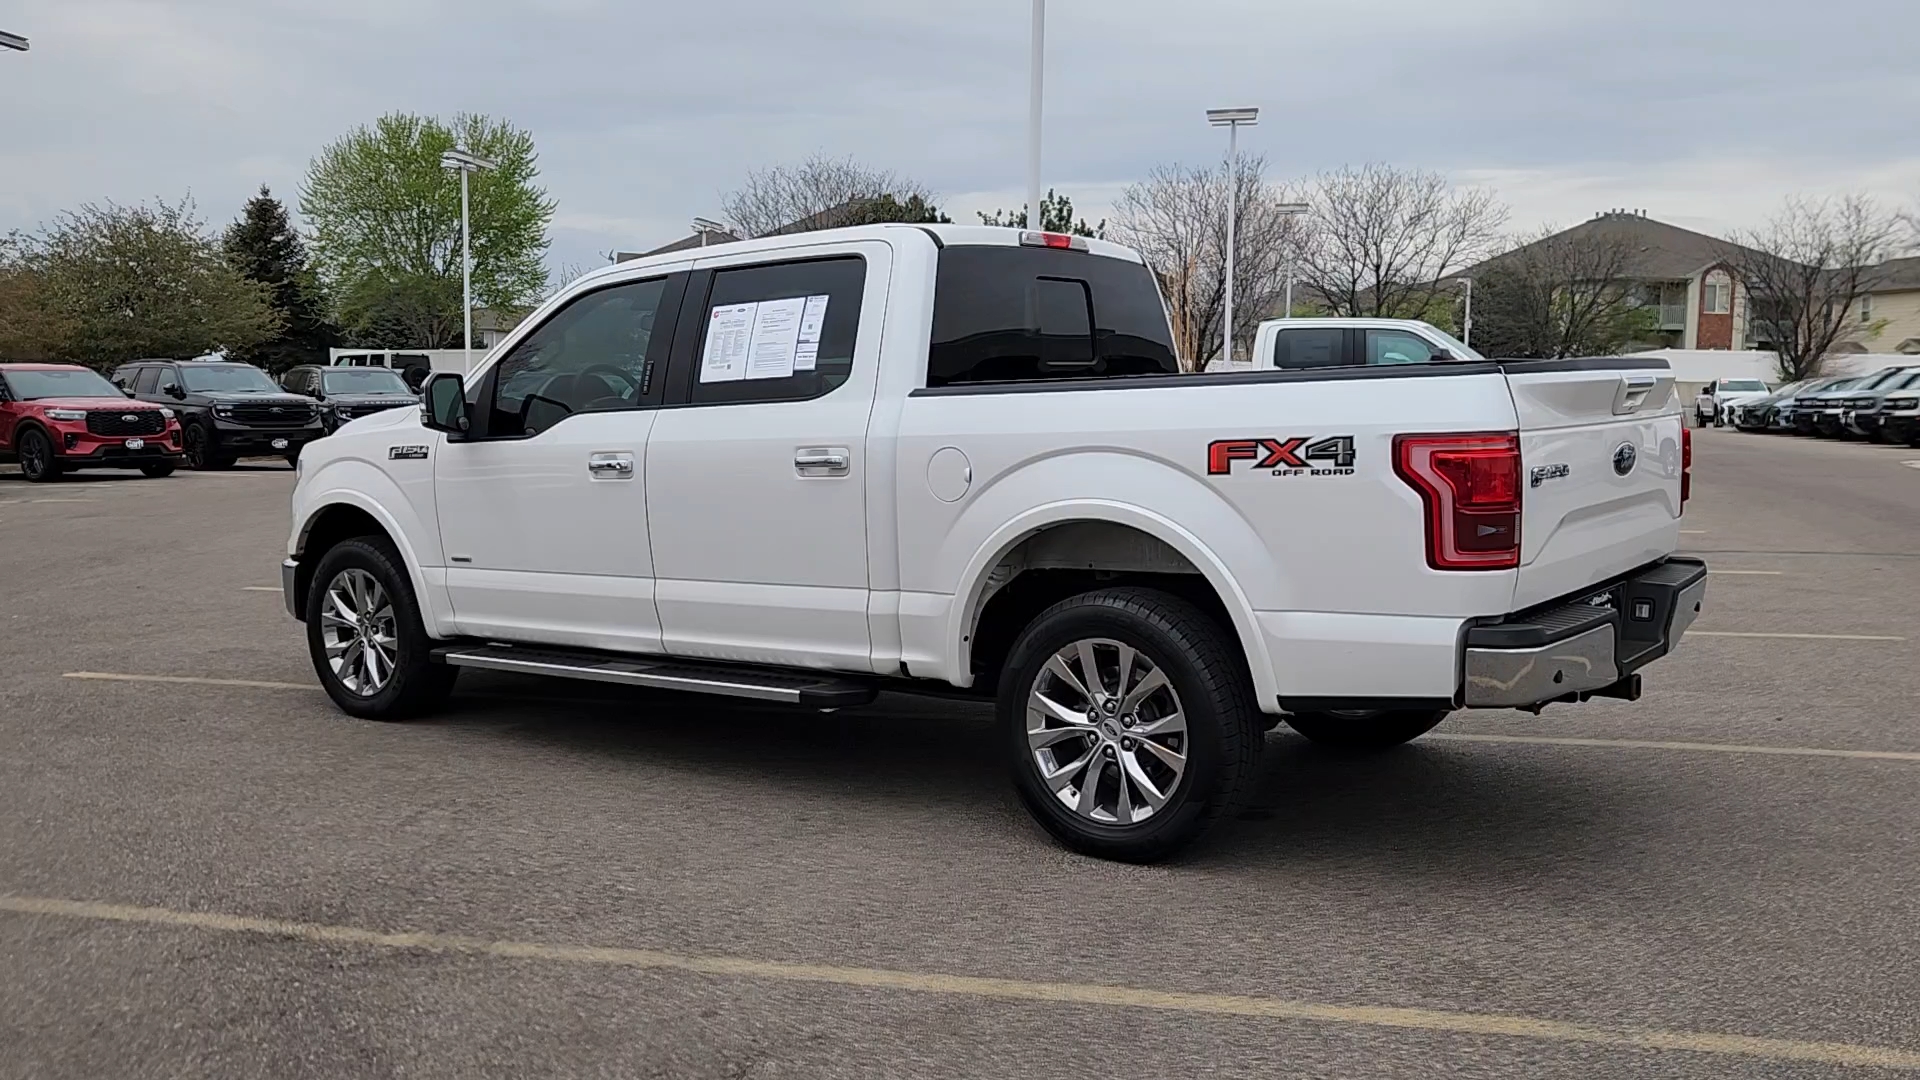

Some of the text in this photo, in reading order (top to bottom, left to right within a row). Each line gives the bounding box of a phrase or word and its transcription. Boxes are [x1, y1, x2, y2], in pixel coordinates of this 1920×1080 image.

[1207, 435, 1356, 475] FX4
[1272, 468, 1355, 477] OFF ROAD
